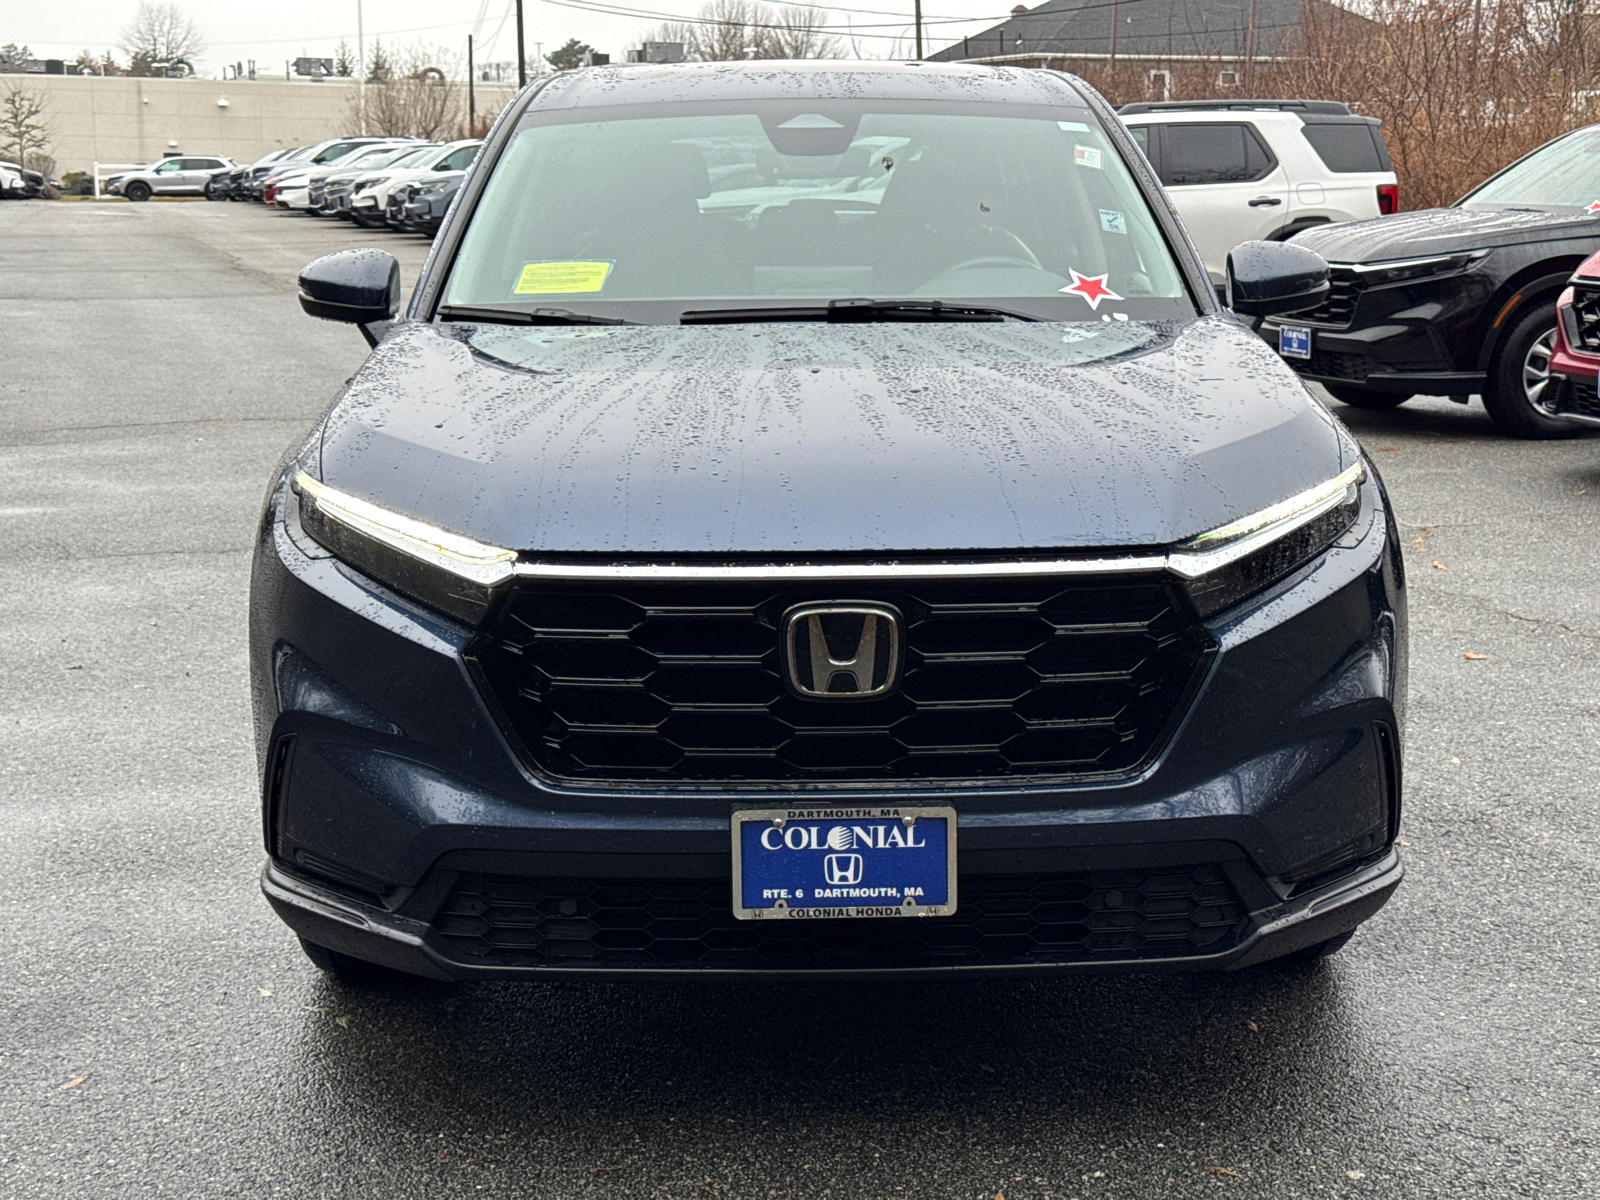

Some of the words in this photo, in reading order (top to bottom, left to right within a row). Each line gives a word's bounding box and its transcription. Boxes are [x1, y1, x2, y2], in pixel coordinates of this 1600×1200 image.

[760, 825, 926, 850] COLONIAL
[763, 889, 792, 898] RTE.
[795, 889, 804, 898] 6
[814, 888, 900, 898] DARTMOUTH,
[904, 887, 924, 896] MA
[788, 908, 852, 918] COLONIAL
[856, 907, 902, 917] HONDA
